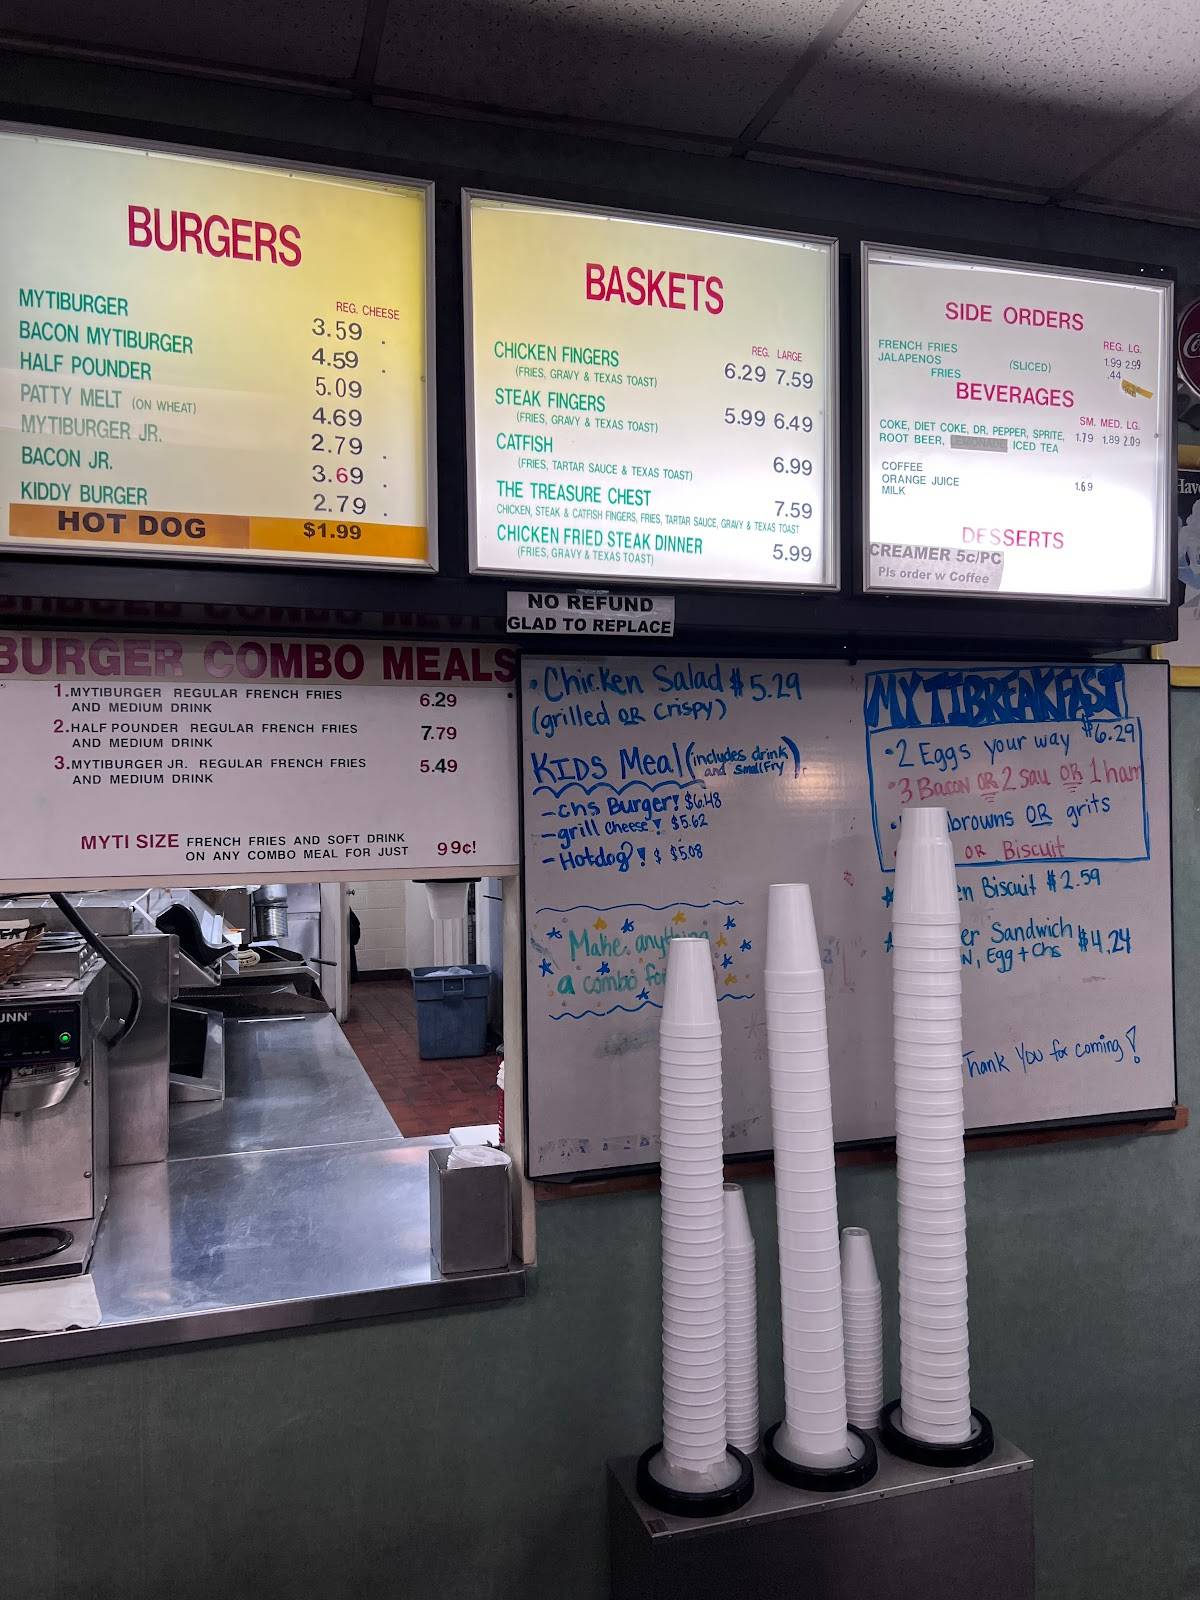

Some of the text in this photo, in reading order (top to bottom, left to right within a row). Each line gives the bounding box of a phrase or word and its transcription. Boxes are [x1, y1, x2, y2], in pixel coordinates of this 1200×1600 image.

[128, 205, 301, 266] BURGERS
[586, 263, 723, 314] BASKETS
[20, 288, 362, 340] MYTIBURGER 3.59
[363, 304, 400, 319] CHEESE
[945, 302, 1083, 331] SIDE ORDERS
[20, 320, 359, 369] BACON MYTIBURGER 4.59
[494, 341, 619, 367] CHICKEN FINGERS
[752, 346, 804, 362] REG. LARGE
[879, 339, 957, 353] FRENCH FRIES
[1104, 341, 1124, 352] REG.
[878, 352, 942, 365] JALAPENOS
[1010, 360, 1051, 374] (SLICED)
[21, 352, 362, 400] HALF POUNDER 5.09
[550, 369, 623, 384] GRAVY TEXAS
[725, 363, 813, 389] 6.29 7.59
[931, 368, 961, 378] FRIES
[21, 383, 362, 427] PATTY MELT (ON WHEAT) 4.69
[496, 388, 605, 412] STEAK FINGERS
[957, 382, 1074, 408] BEVERAGES
[551, 415, 623, 430] GRAVY TEXAS
[725, 408, 813, 432] 5.99 6.49
[1101, 418, 1123, 429] MED.
[21, 414, 362, 455] MYTIBURGER 2.79
[880, 419, 909, 431] COKE,
[915, 421, 936, 431] DIET
[940, 423, 969, 434] COKE,
[993, 426, 1028, 439] PEPPER,
[1033, 429, 1064, 442] SPRITE,
[1102, 436, 1120, 444] 1.89
[496, 432, 552, 452] CATFISH
[880, 433, 909, 443] ROOT
[1013, 440, 1036, 451] ICED
[1040, 443, 1058, 453] TEA
[22, 446, 363, 485] BACON 3.69
[552, 460, 659, 478] TARTAR SAUCE TEXAS
[774, 457, 812, 476] 6.99
[882, 461, 923, 471] COFFEE
[882, 474, 959, 486] ORANGE JUICE
[21, 481, 366, 515] KIDDY BURGER 2.79
[497, 480, 651, 506] THE TREASURE CHEST
[882, 486, 905, 495] MILK
[536, 506, 690, 525] STEAK CATFISH TARTAR
[775, 501, 812, 519] 7.59
[58, 511, 206, 538] HOT DOG
[304, 523, 362, 538] $1.99
[498, 524, 702, 554] CHICKEN FRIED STEAK DINNER
[963, 527, 1063, 549] DESSERTS
[551, 547, 653, 566] GRAVY TEXAS TOAST)
[773, 544, 812, 562] 5.99
[870, 544, 1001, 564] CREAMER 5c/PC
[879, 567, 989, 584] Pls order Coffee
[528, 594, 653, 612] NO REFUND
[508, 616, 671, 633] GLAD TO REPLACE
[0, 637, 517, 681] BURGER COMBO MEALS
[544, 663, 723, 701] Chicken Salad
[72, 703, 212, 712] AND MEDIUM DRINK
[174, 688, 457, 707] REGULAR FRENCH FRIES 6.29
[619, 705, 645, 725] OR
[110, 722, 456, 740] POUNDER REGULAR FRENCH FRIES 7.79
[922, 714, 1135, 771] Eggs your way $6.29
[167, 759, 457, 773] JR. REGULAR FRENCH FRIES 5.49
[531, 742, 682, 783] KIDS Meal
[685, 791, 721, 810] $6.48
[1067, 793, 1110, 827] grits
[672, 814, 708, 830] $5.62
[82, 833, 404, 849] MYTI SIZE FRENCH FRIES AND SOFT DRINK
[1004, 836, 1065, 860] Biscuit
[186, 847, 408, 861] ON ANY COMBO MEAL FOR JUST
[981, 874, 1036, 899] Biscuit
[992, 916, 1072, 942] Sandwich
[987, 948, 1012, 973] Egg
[583, 969, 638, 994] combo
[962, 1040, 1068, 1077] Thank You for
